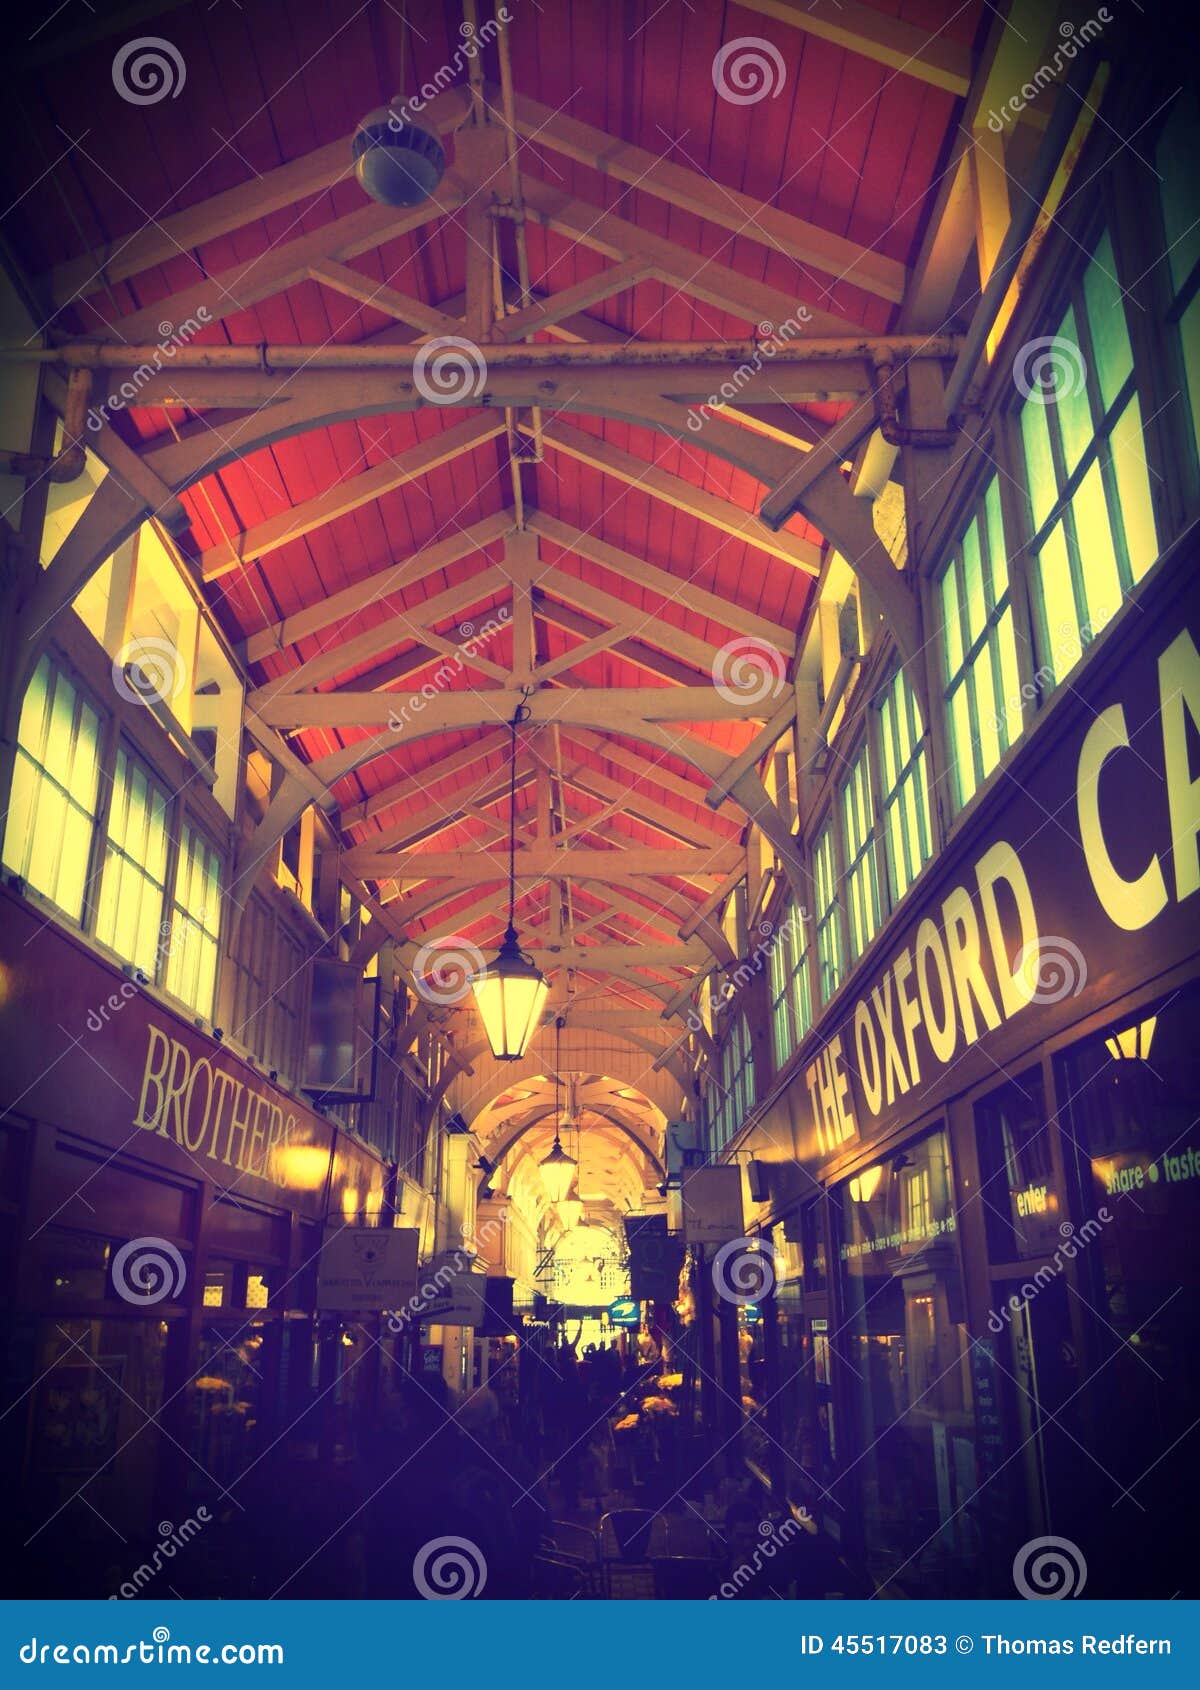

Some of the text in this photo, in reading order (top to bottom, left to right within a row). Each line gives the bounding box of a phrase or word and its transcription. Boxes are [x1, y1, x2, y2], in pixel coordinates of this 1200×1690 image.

[805, 1034, 856, 1157] THE
[854, 840, 1040, 1117] OXFORD
[1106, 1146, 1200, 1195] share taste
[1016, 1183, 1048, 1217] enter
